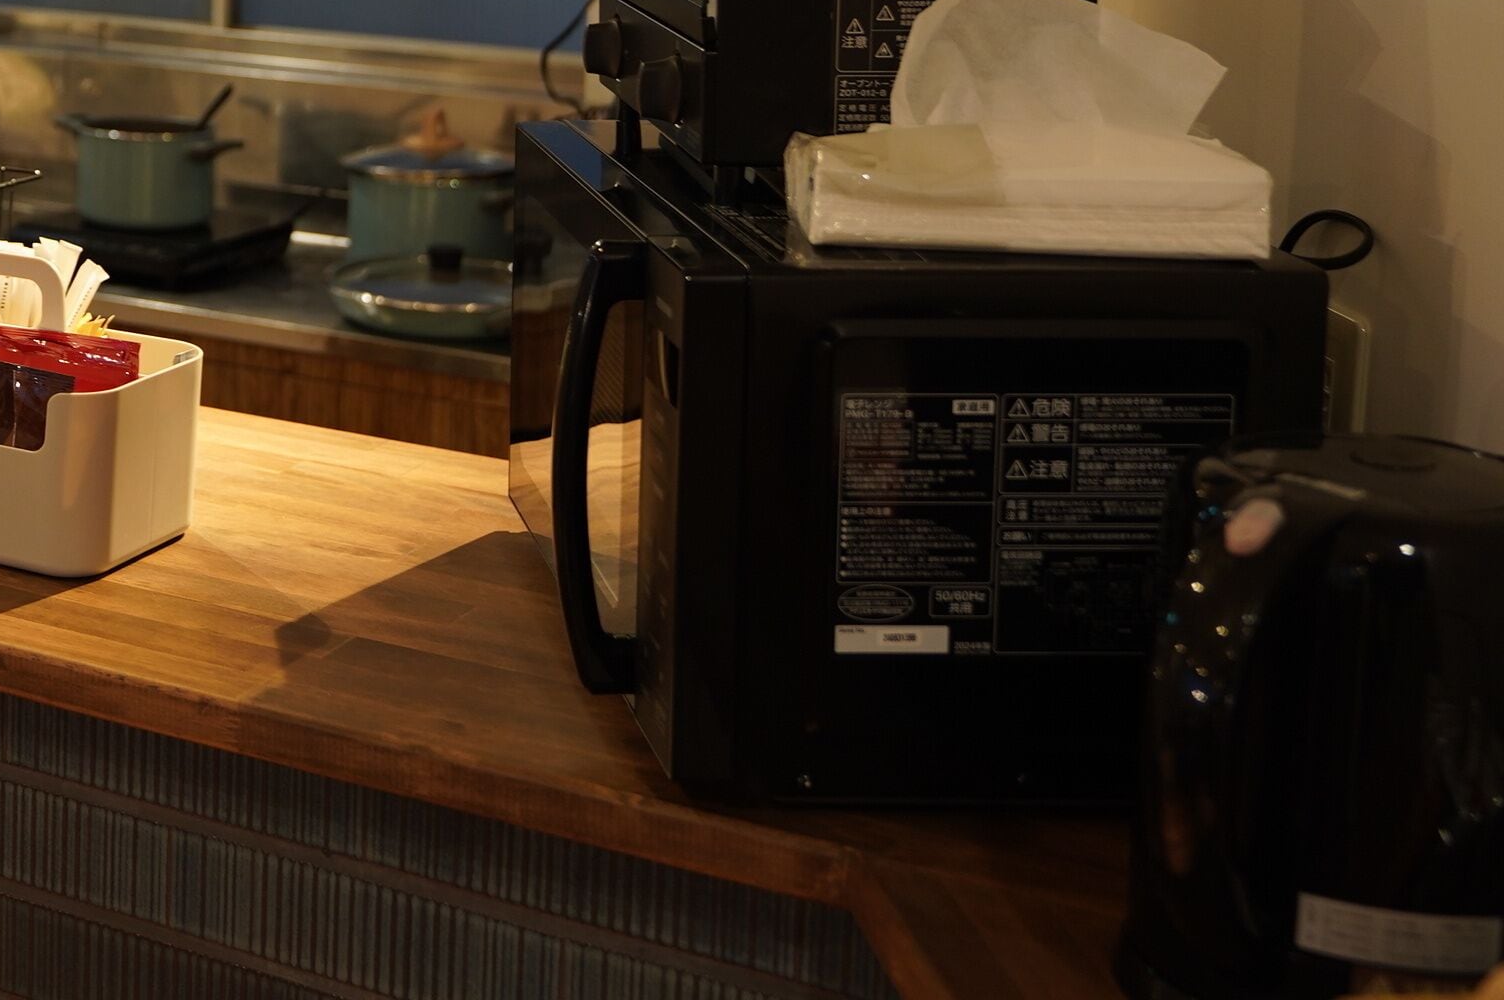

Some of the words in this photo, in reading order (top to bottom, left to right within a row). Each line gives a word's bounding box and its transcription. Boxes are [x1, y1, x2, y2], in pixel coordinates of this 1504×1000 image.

[841, 36, 867, 49] 注意
[844, 399, 892, 409] 電子レンジ
[1032, 398, 1072, 418] 危険
[1031, 423, 1070, 442] 警告
[1029, 459, 1069, 480] 注意
[935, 590, 986, 601] 50/60Hz
